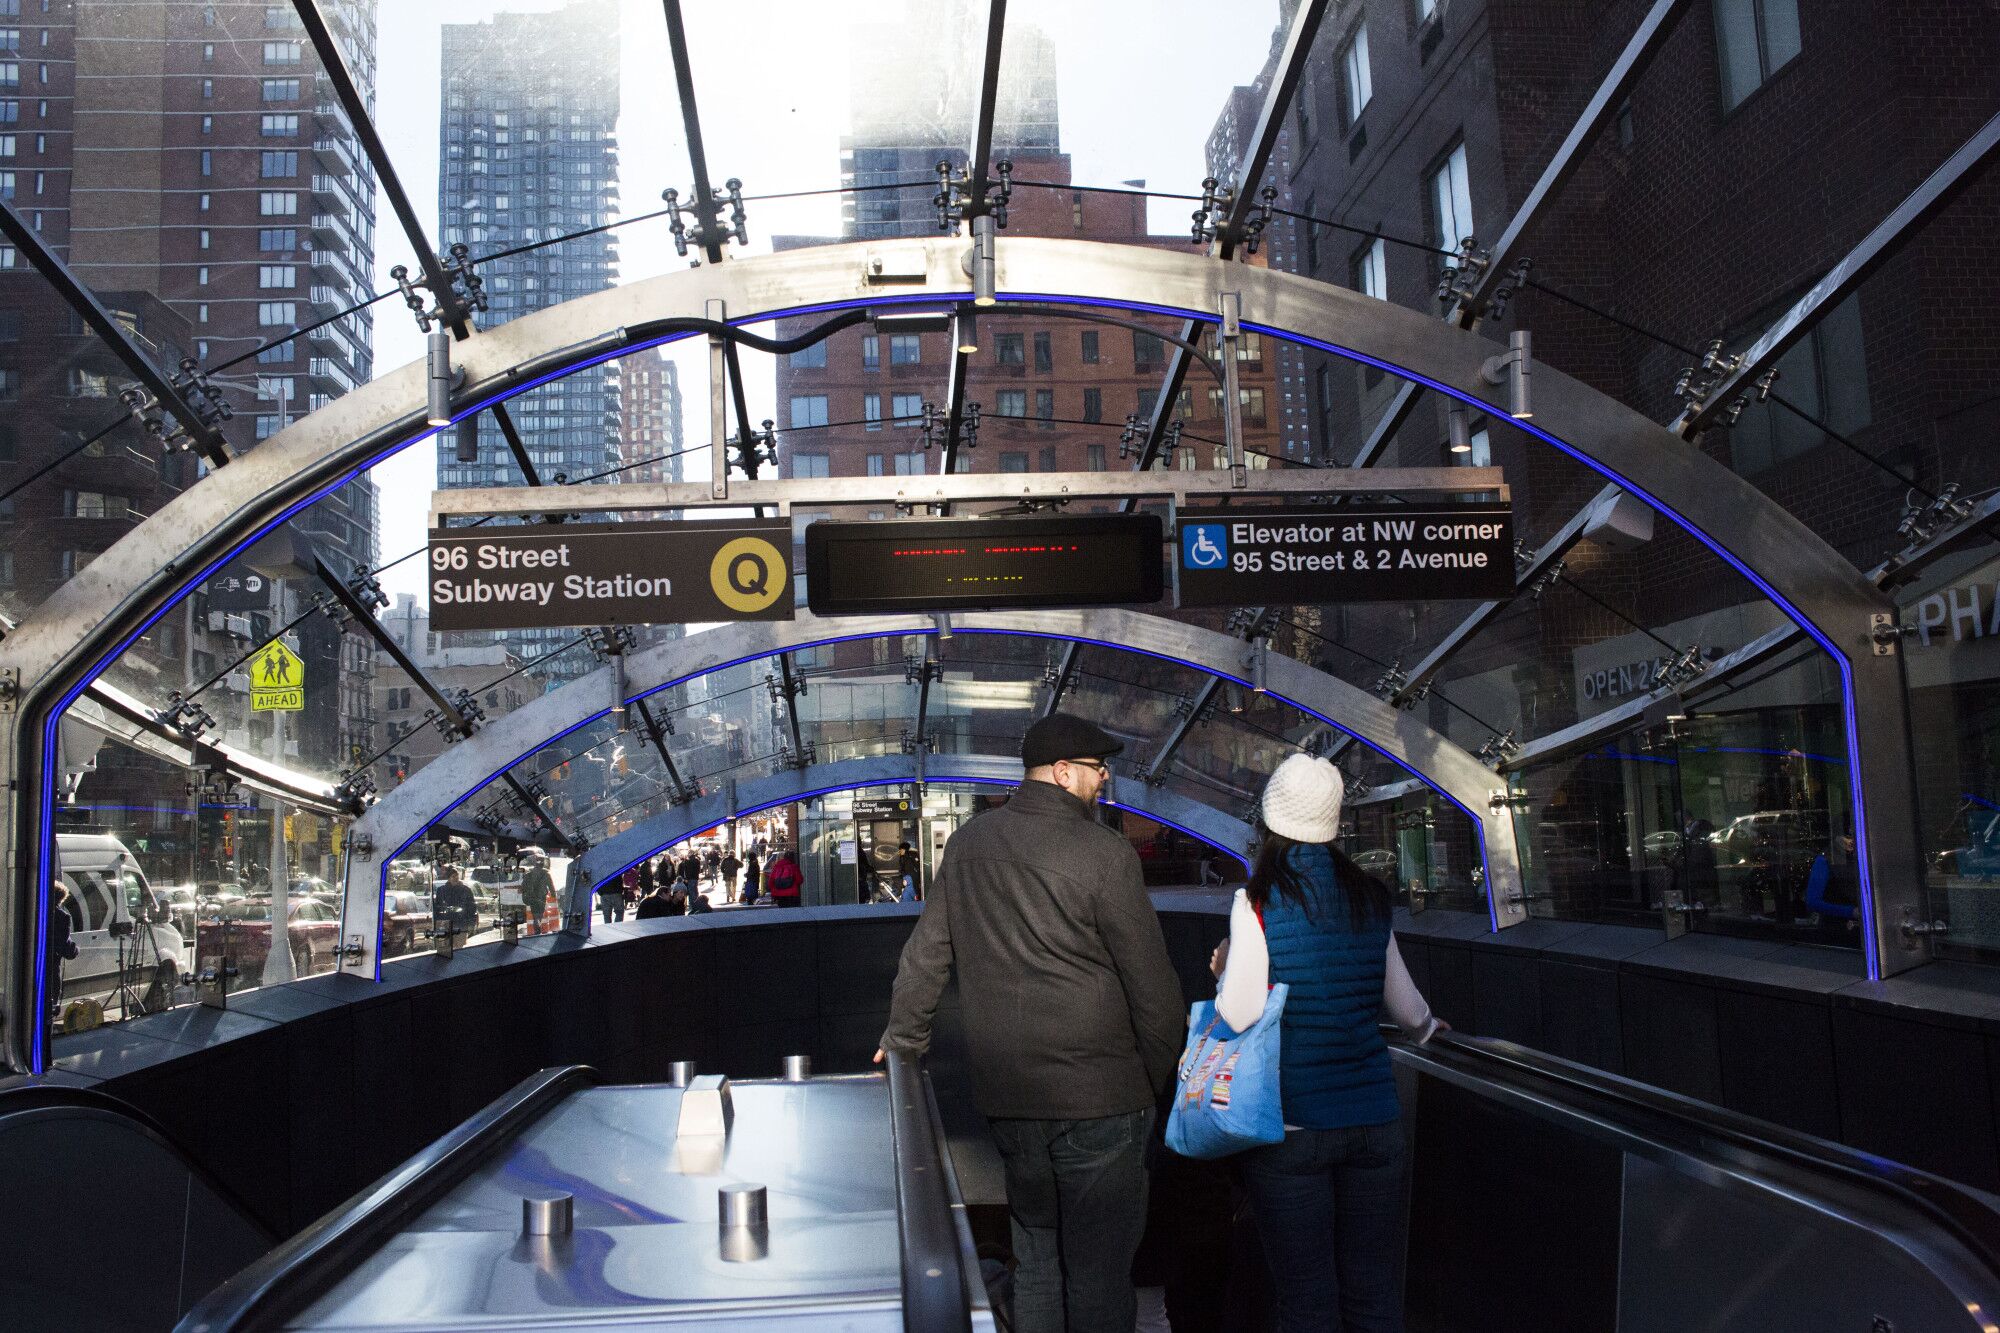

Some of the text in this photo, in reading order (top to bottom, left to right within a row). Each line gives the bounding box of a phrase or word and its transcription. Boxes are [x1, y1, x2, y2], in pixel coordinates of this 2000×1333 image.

[1232, 520, 1504, 545] Elevator at NW corner
[432, 543, 570, 571] 96 Street
[1232, 548, 1488, 573] 95 Street & 2 Avenue
[727, 552, 769, 598] Q
[433, 574, 672, 606] Subway Station
[1583, 664, 1633, 700] OPEN
[257, 693, 297, 706] AHEAD
